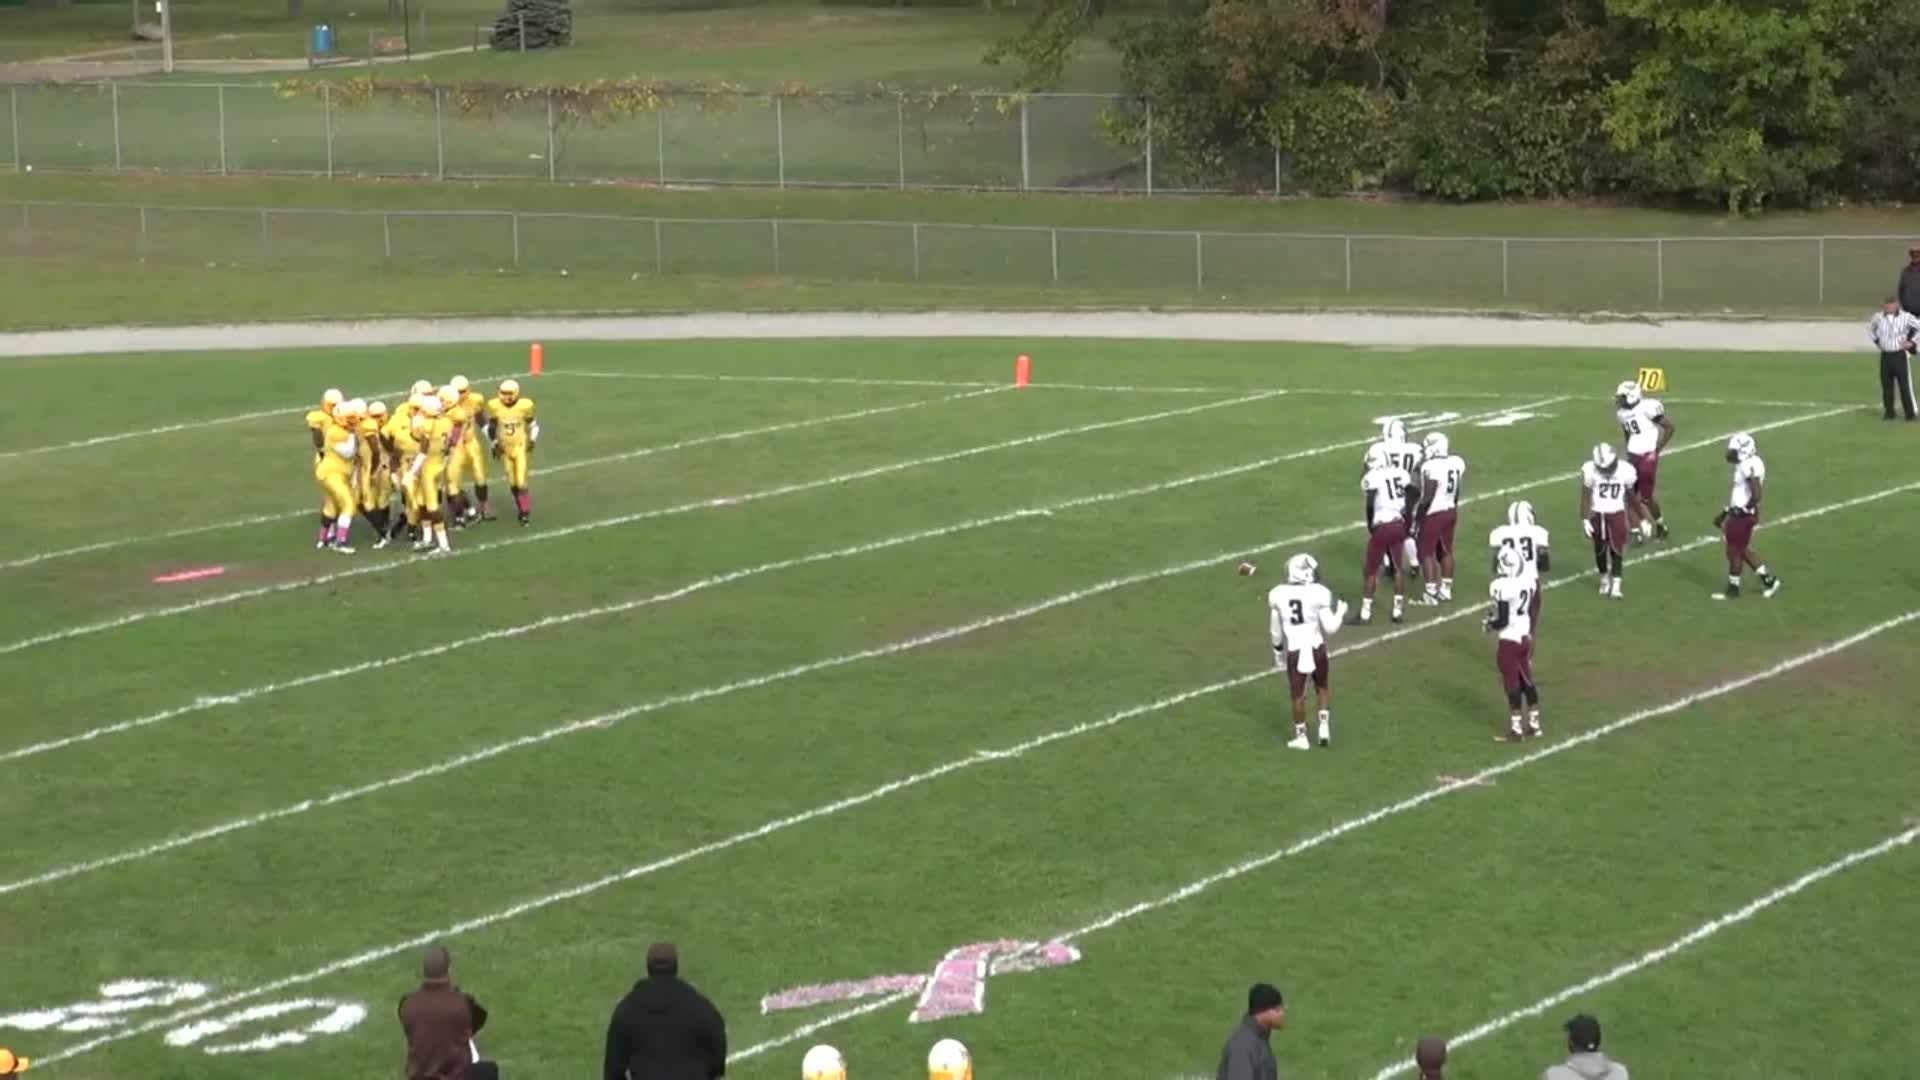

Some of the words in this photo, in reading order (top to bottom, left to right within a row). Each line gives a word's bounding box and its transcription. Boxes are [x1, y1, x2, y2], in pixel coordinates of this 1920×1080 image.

[1640, 371, 1659, 389] 10
[1385, 477, 1404, 499] 15
[1599, 483, 1620, 499] 20
[1288, 599, 1304, 625] 3
